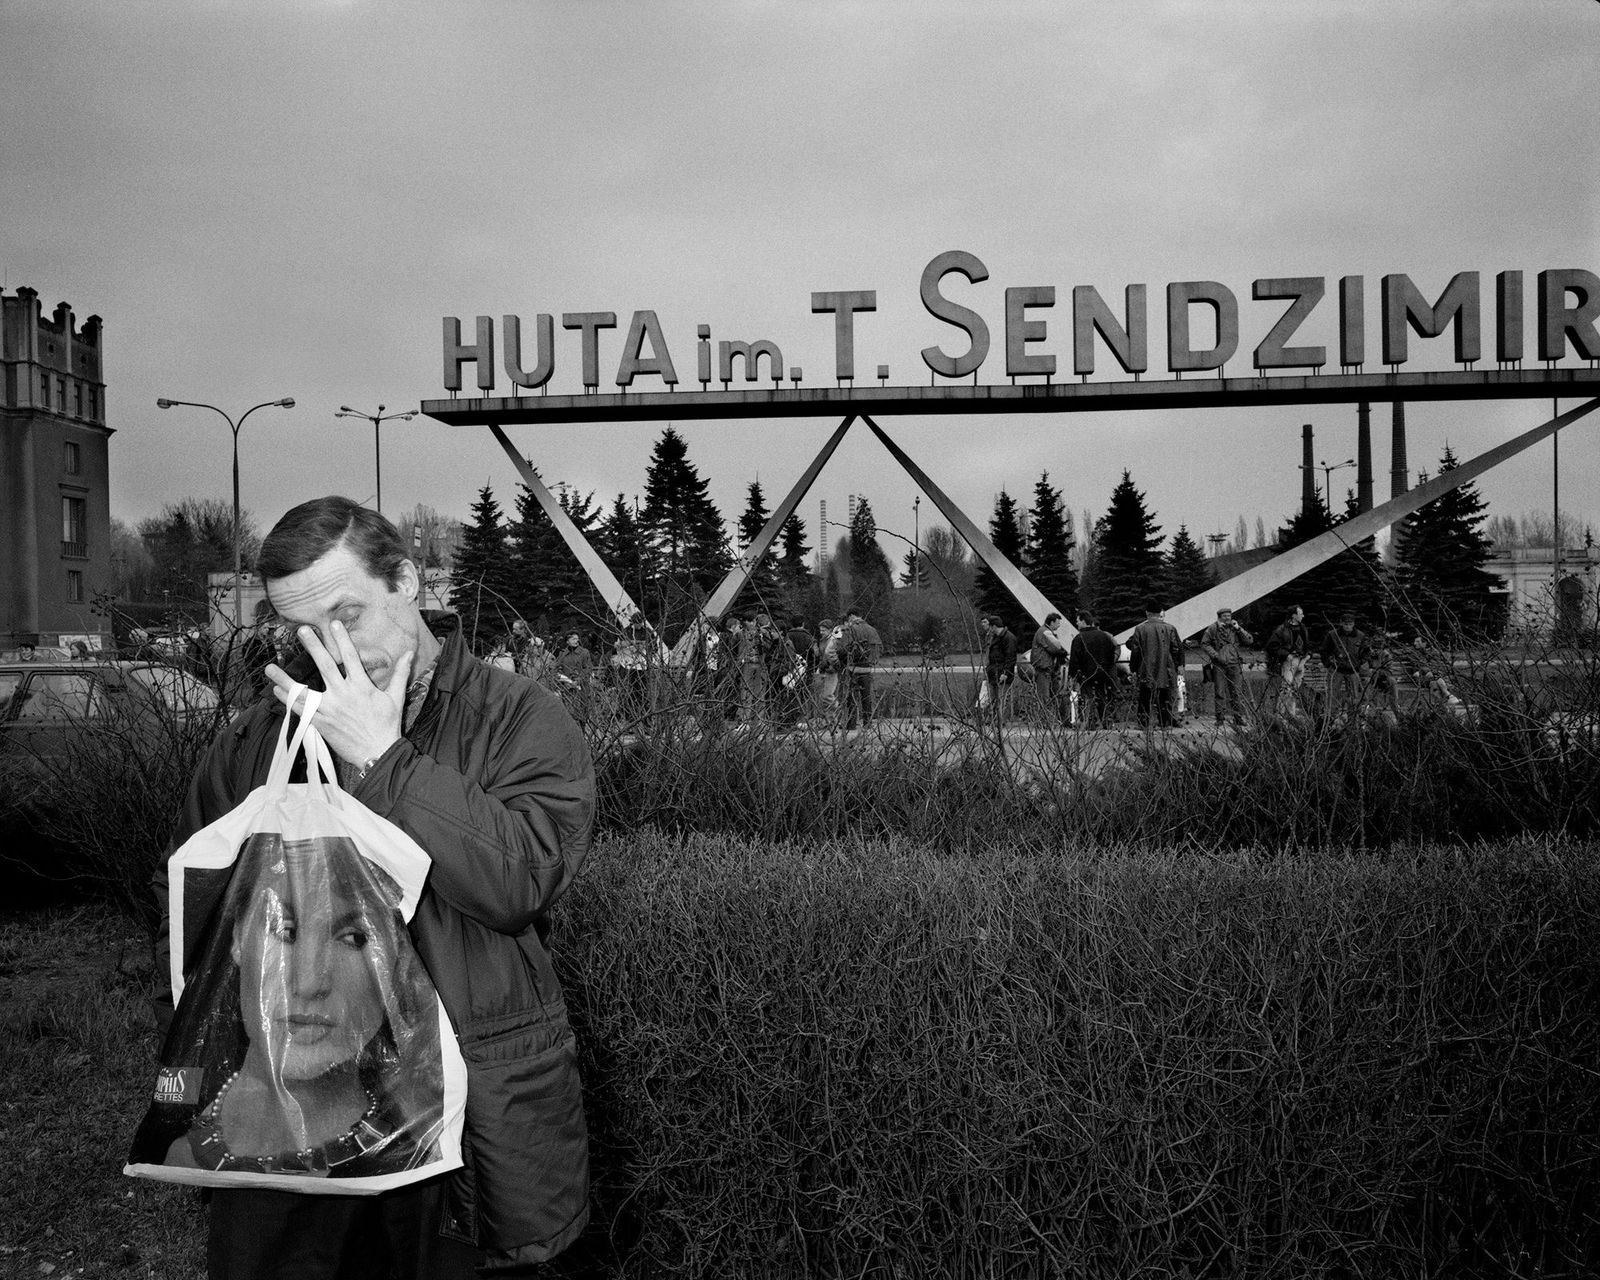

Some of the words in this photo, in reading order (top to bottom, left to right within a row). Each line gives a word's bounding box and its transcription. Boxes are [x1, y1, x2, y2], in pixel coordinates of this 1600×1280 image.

[442, 309, 679, 391] HUTA
[697, 323, 803, 383] im.
[810, 289, 890, 381] T.
[919, 249, 1600, 379] SENDZIMIR
